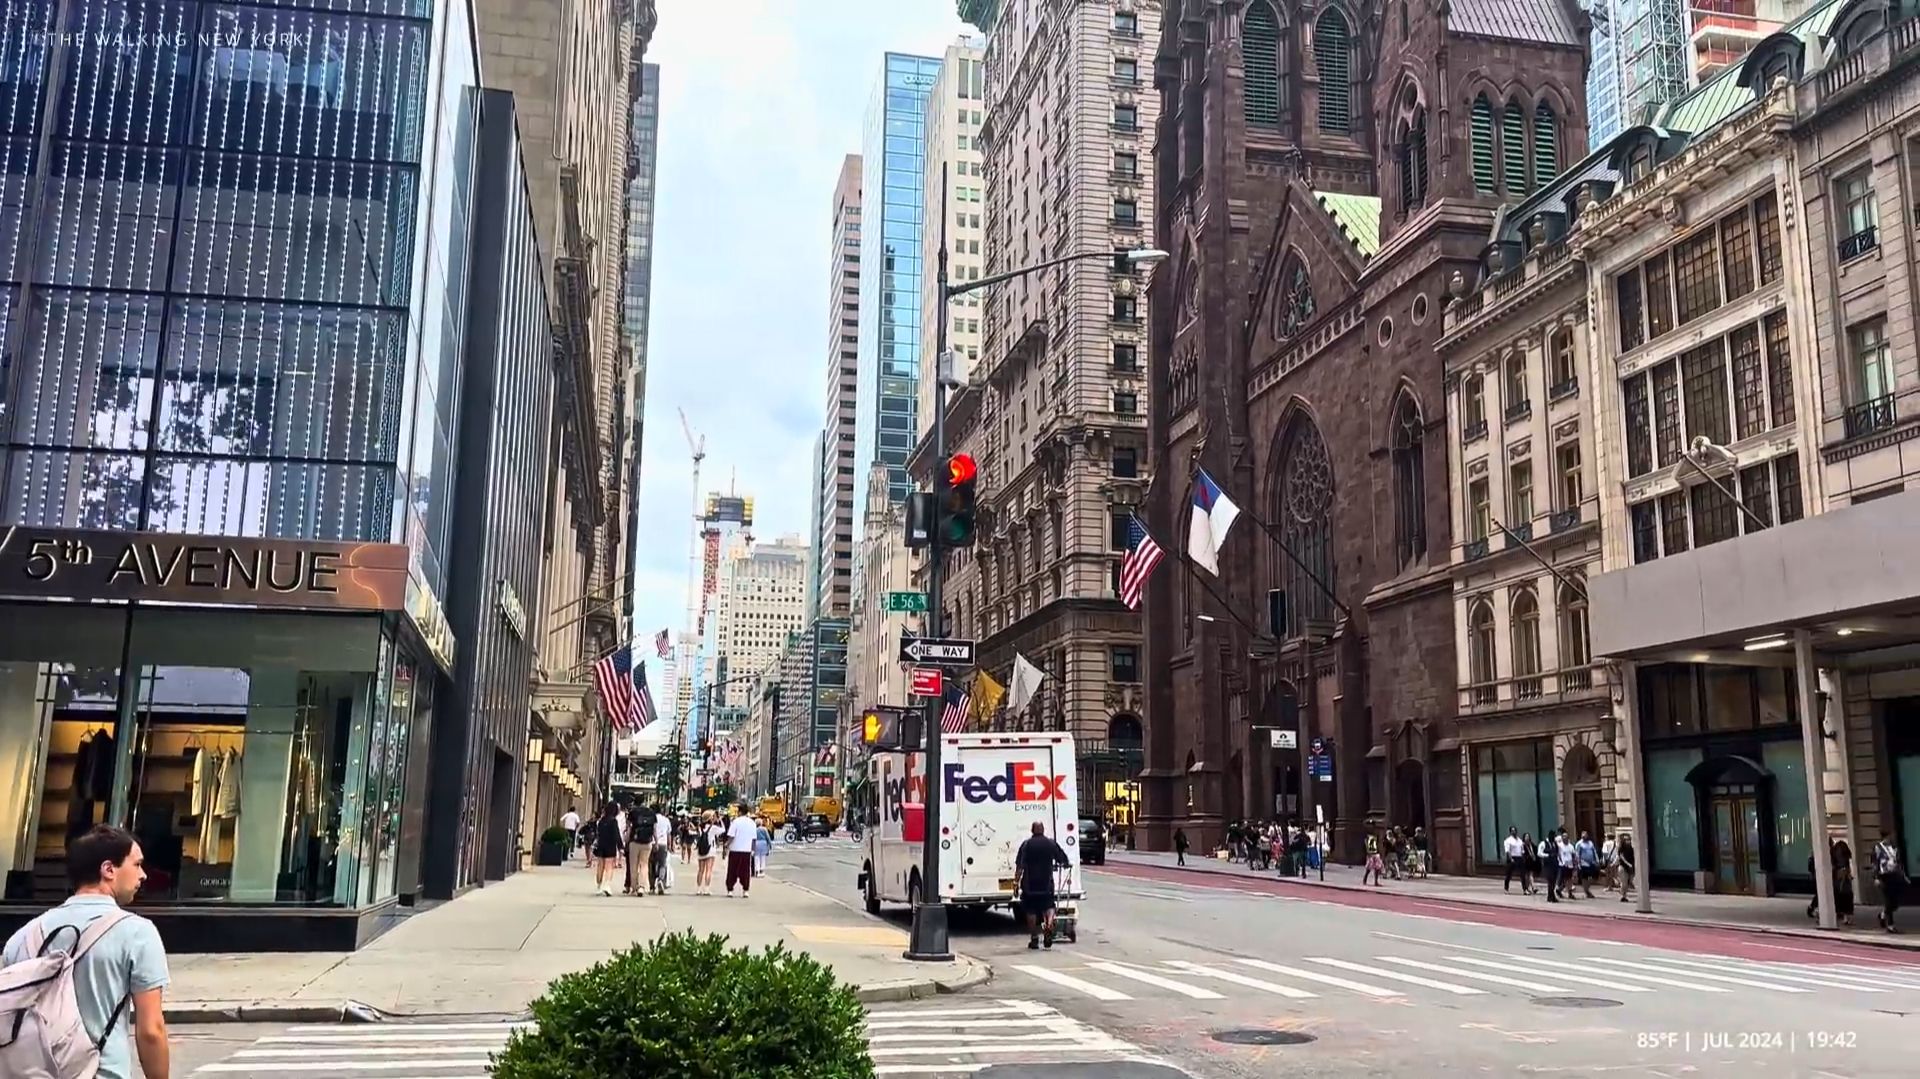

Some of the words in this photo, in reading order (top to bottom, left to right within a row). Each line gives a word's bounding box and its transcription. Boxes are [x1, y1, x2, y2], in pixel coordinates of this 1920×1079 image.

[26, 538, 93, 582] 5th
[107, 543, 342, 594] AVENUE
[891, 594, 897, 609] E
[901, 594, 914, 609] 56
[911, 645, 932, 656] ONE
[942, 647, 965, 657] WAY
[944, 762, 1067, 803] FedEx
[1015, 803, 1047, 811] Express
